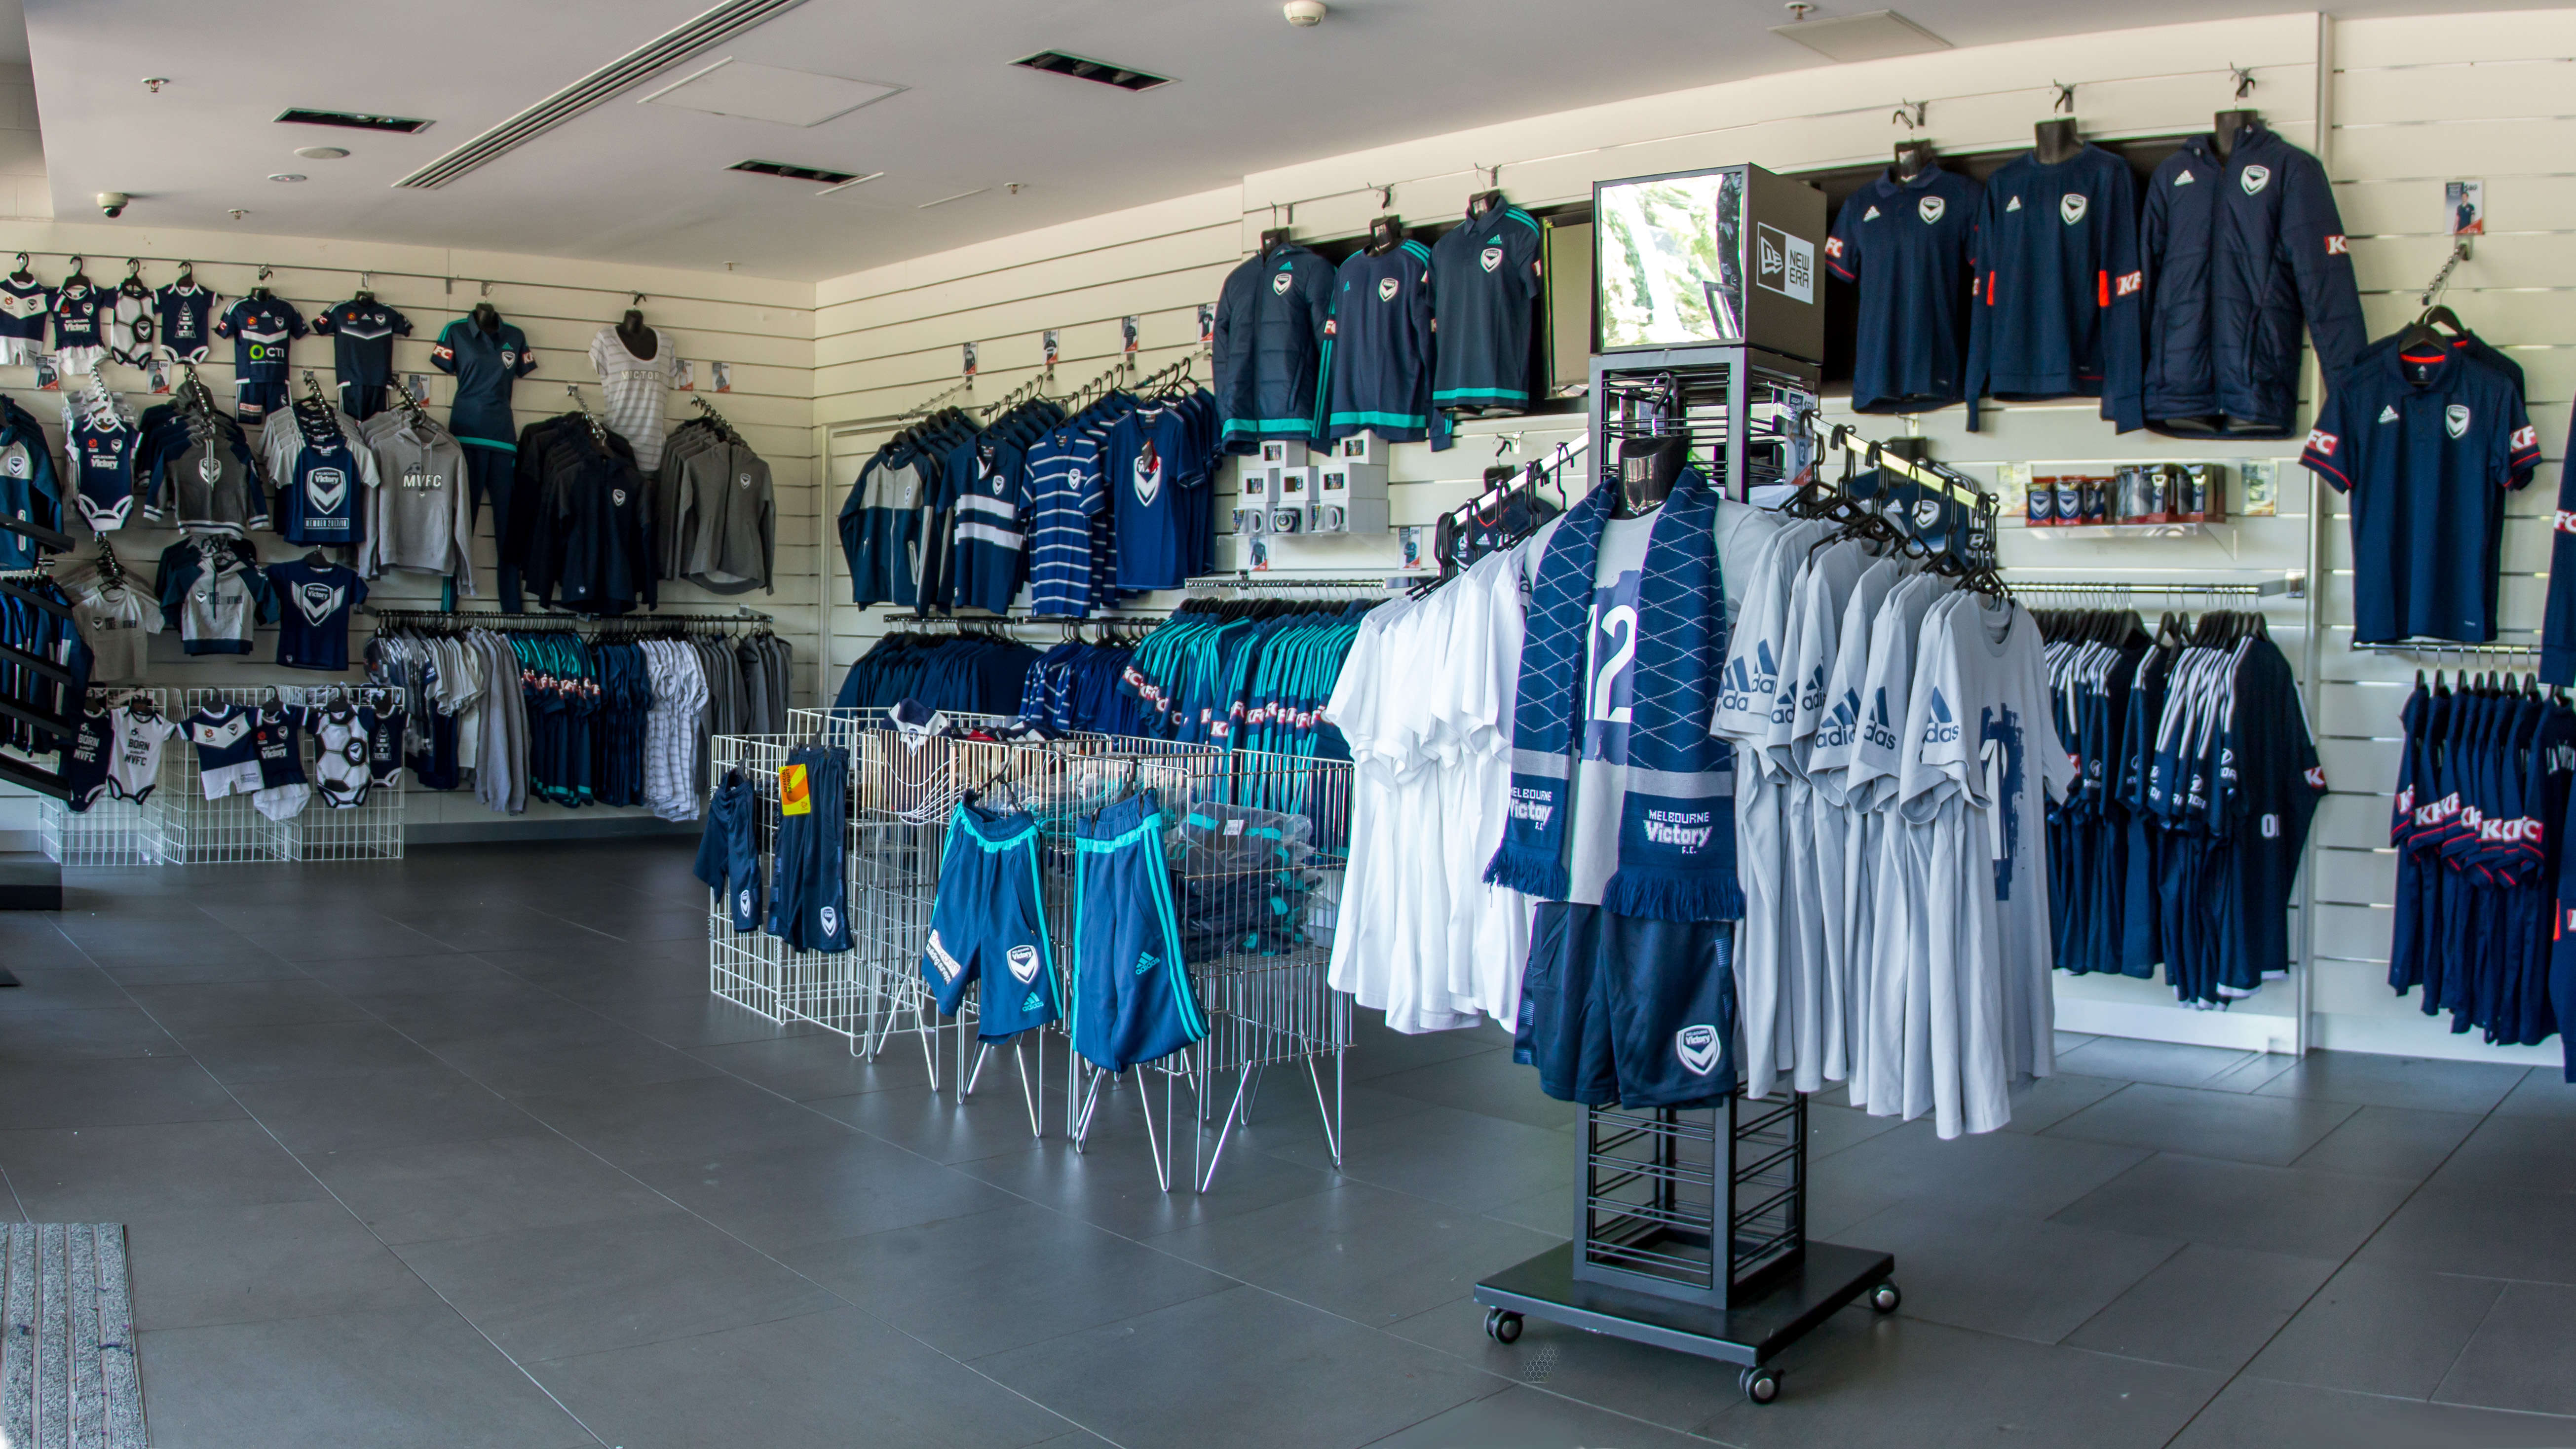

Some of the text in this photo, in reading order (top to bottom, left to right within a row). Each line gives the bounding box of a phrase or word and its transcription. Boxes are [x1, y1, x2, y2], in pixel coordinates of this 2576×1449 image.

[1825, 237, 1844, 258] FC
[1790, 249, 1809, 271] NEW
[1789, 267, 1809, 289] ERA
[2117, 270, 2141, 296] KF
[266, 347, 285, 357] CTI
[433, 346, 453, 359] FC
[523, 352, 533, 364] KF
[621, 371, 664, 381] VICTORY
[2306, 429, 2338, 454] FC
[2510, 425, 2536, 453] KF
[315, 475, 339, 484] Victory
[403, 474, 442, 487] MVFC
[2554, 510, 2576, 532] FC
[308, 590, 328, 600] Victory
[1586, 604, 1638, 724] 12
[78, 733, 100, 748] BORN
[1815, 725, 1856, 748] adi
[1863, 722, 1896, 750] das
[1925, 723, 1959, 743] das
[128, 738, 150, 751] BORN
[74, 748, 96, 763] MVFC
[124, 753, 147, 766] MVFC
[261, 748, 287, 759] Victory
[1649, 809, 1710, 824] MELBOURNE
[1643, 819, 1713, 848] Victory
[925, 943, 941, 966] building
[931, 933, 960, 974] cpoint
[1012, 951, 1032, 960] Victory
[1136, 957, 1160, 975] adidas
[1022, 1000, 1044, 1012] adidas
[1685, 1034, 1710, 1045] Victory
